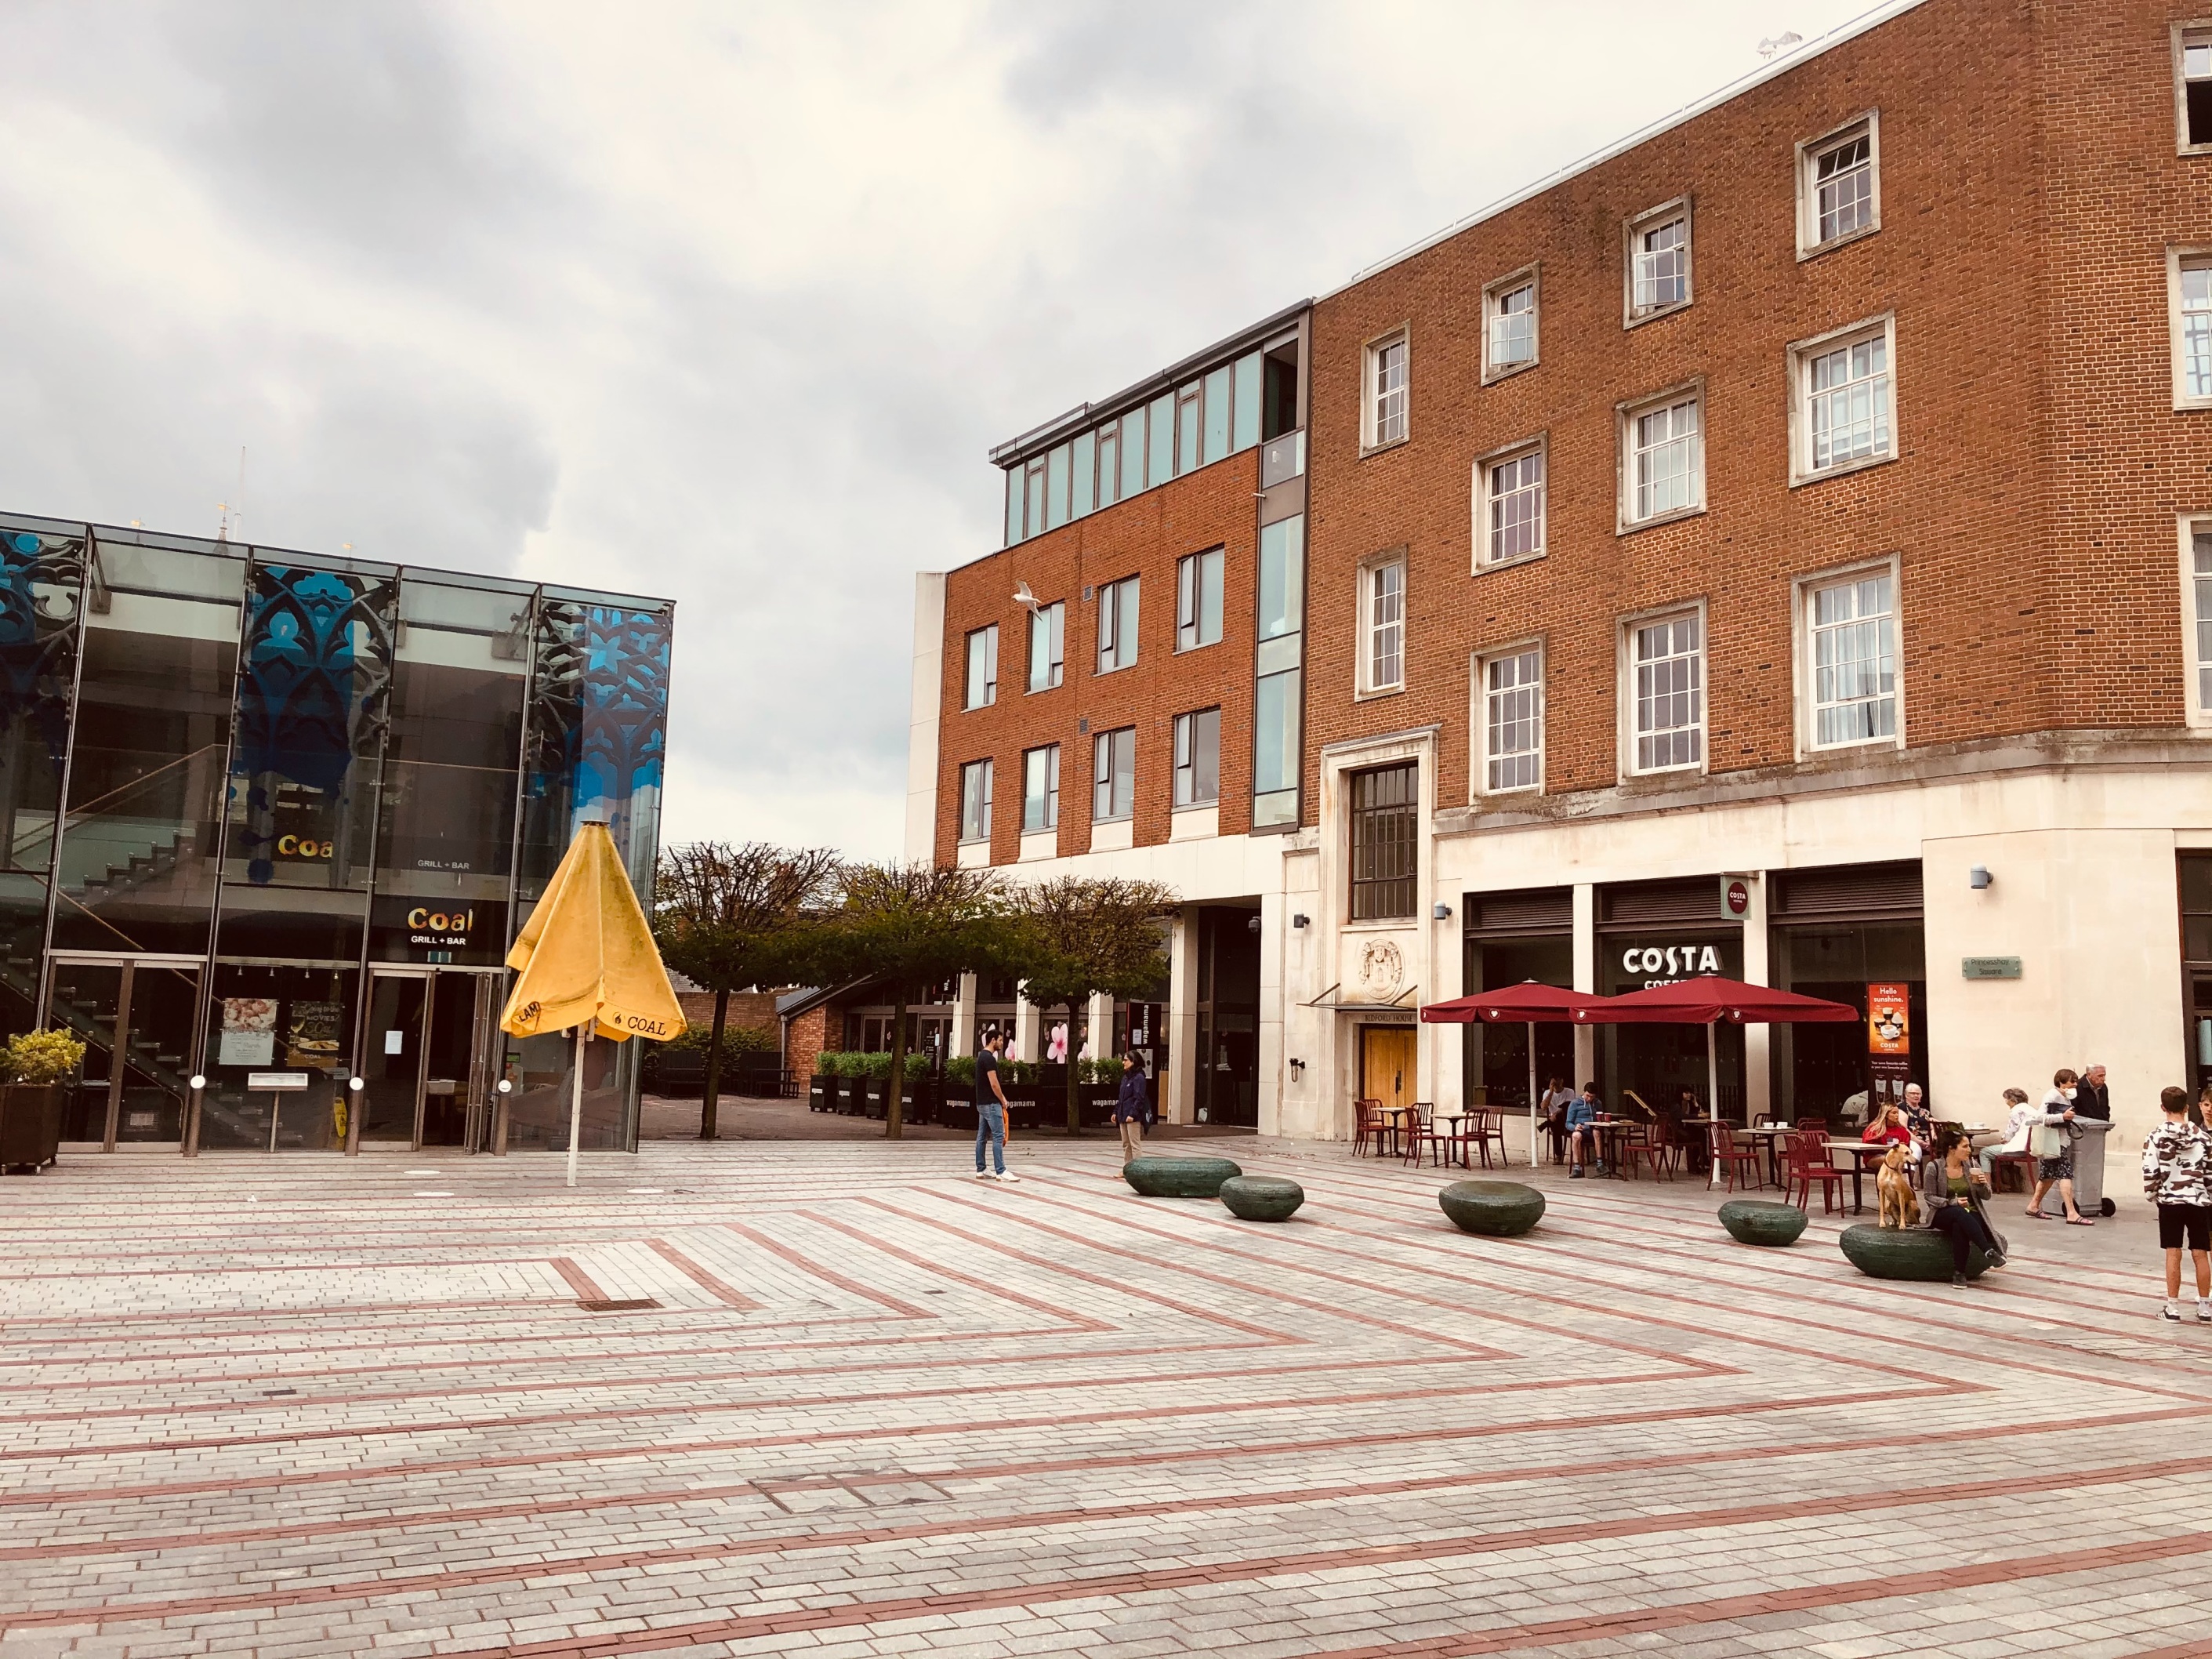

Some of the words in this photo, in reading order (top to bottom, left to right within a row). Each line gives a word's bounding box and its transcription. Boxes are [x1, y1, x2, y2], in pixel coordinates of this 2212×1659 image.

[278, 834, 333, 858] Coa
[418, 859, 443, 868] GRILL
[1729, 891, 1746, 900] COSTA
[408, 907, 473, 931] Coal
[411, 935, 437, 944] GRILL
[1623, 946, 1721, 975] COSTA
[628, 1016, 667, 1036] COAL
[946, 1099, 970, 1108] wagamama
[1006, 1100, 1035, 1109] agamama
